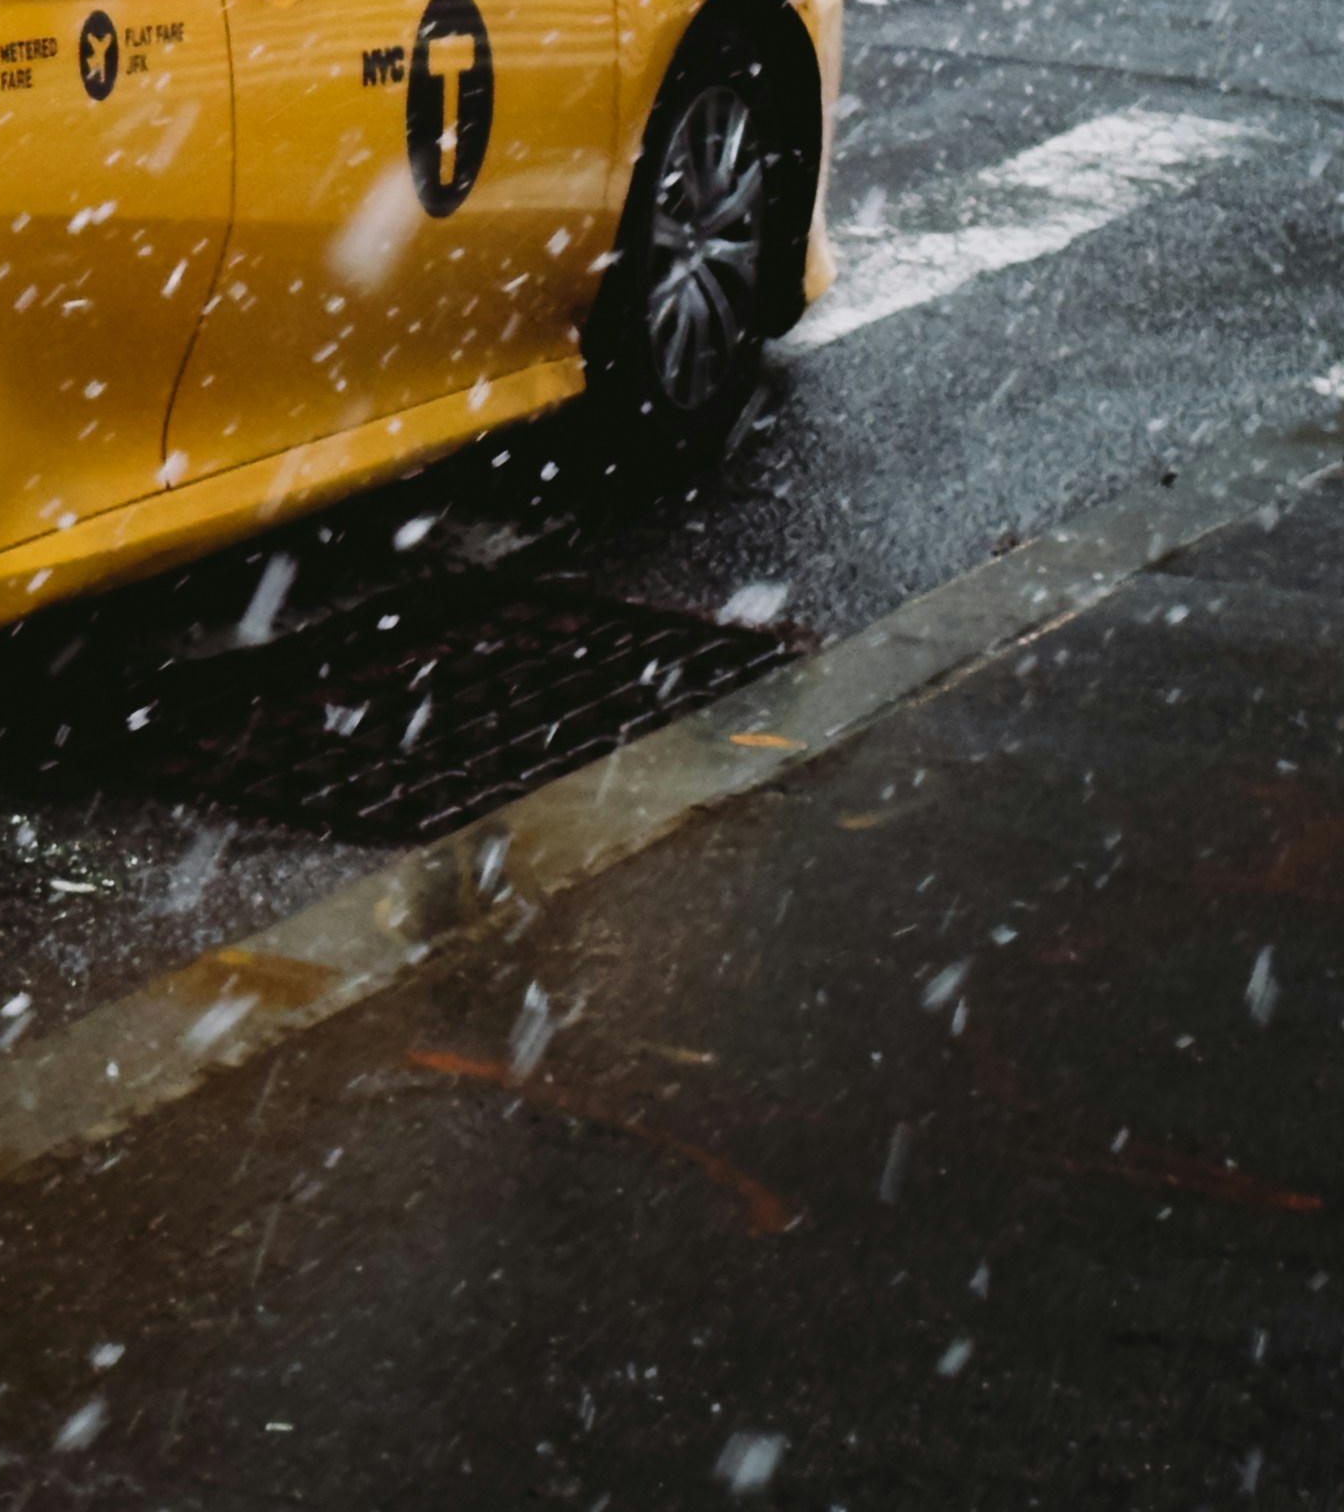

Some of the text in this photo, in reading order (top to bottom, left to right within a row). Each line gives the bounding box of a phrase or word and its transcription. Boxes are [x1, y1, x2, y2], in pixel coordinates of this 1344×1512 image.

[124, 22, 185, 47] FLAT FARE
[0, 37, 58, 63] METERED
[126, 54, 149, 76] JFK
[0, 68, 33, 92] FARE
[362, 32, 476, 188] NYC T
